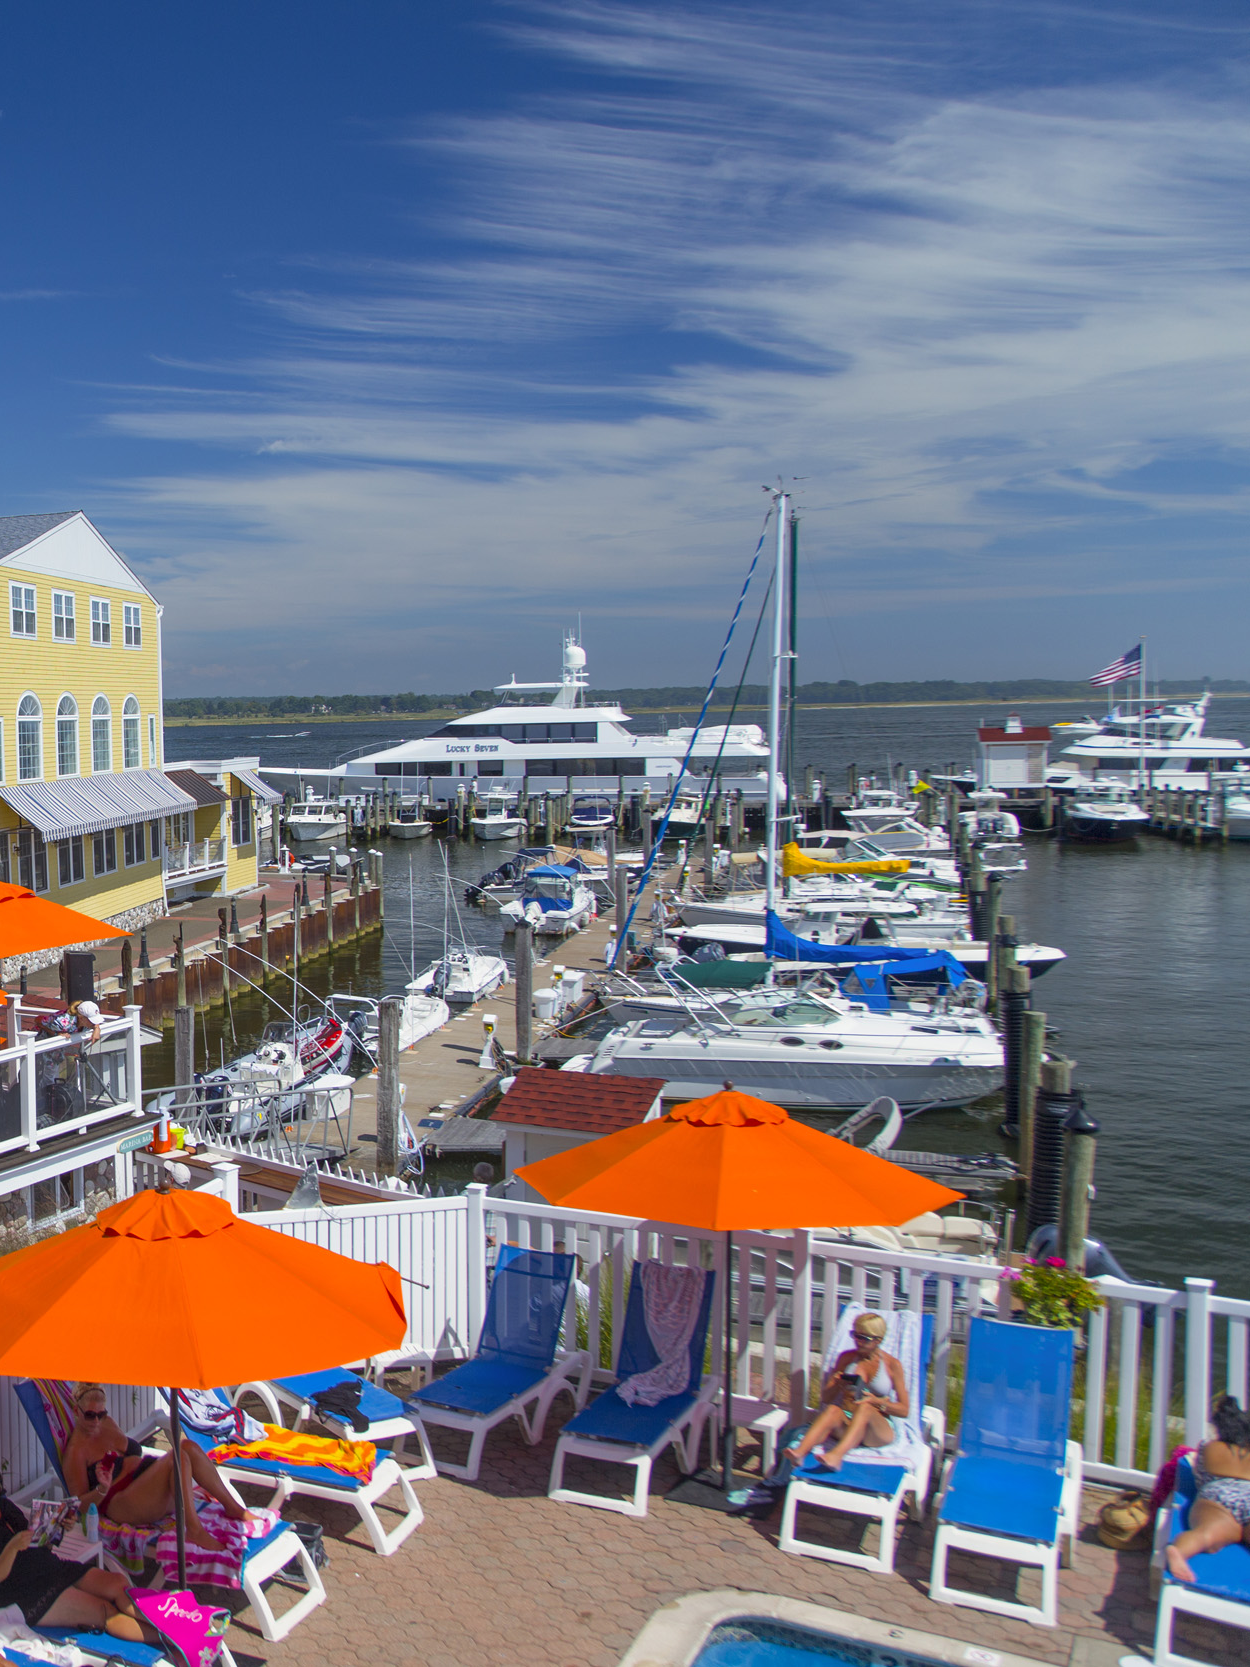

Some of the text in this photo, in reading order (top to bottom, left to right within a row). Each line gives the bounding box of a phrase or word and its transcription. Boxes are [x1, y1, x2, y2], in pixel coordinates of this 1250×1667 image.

[446, 743, 499, 753] LUCKY SEVEN
[120, 1138, 141, 1151] MARINA
